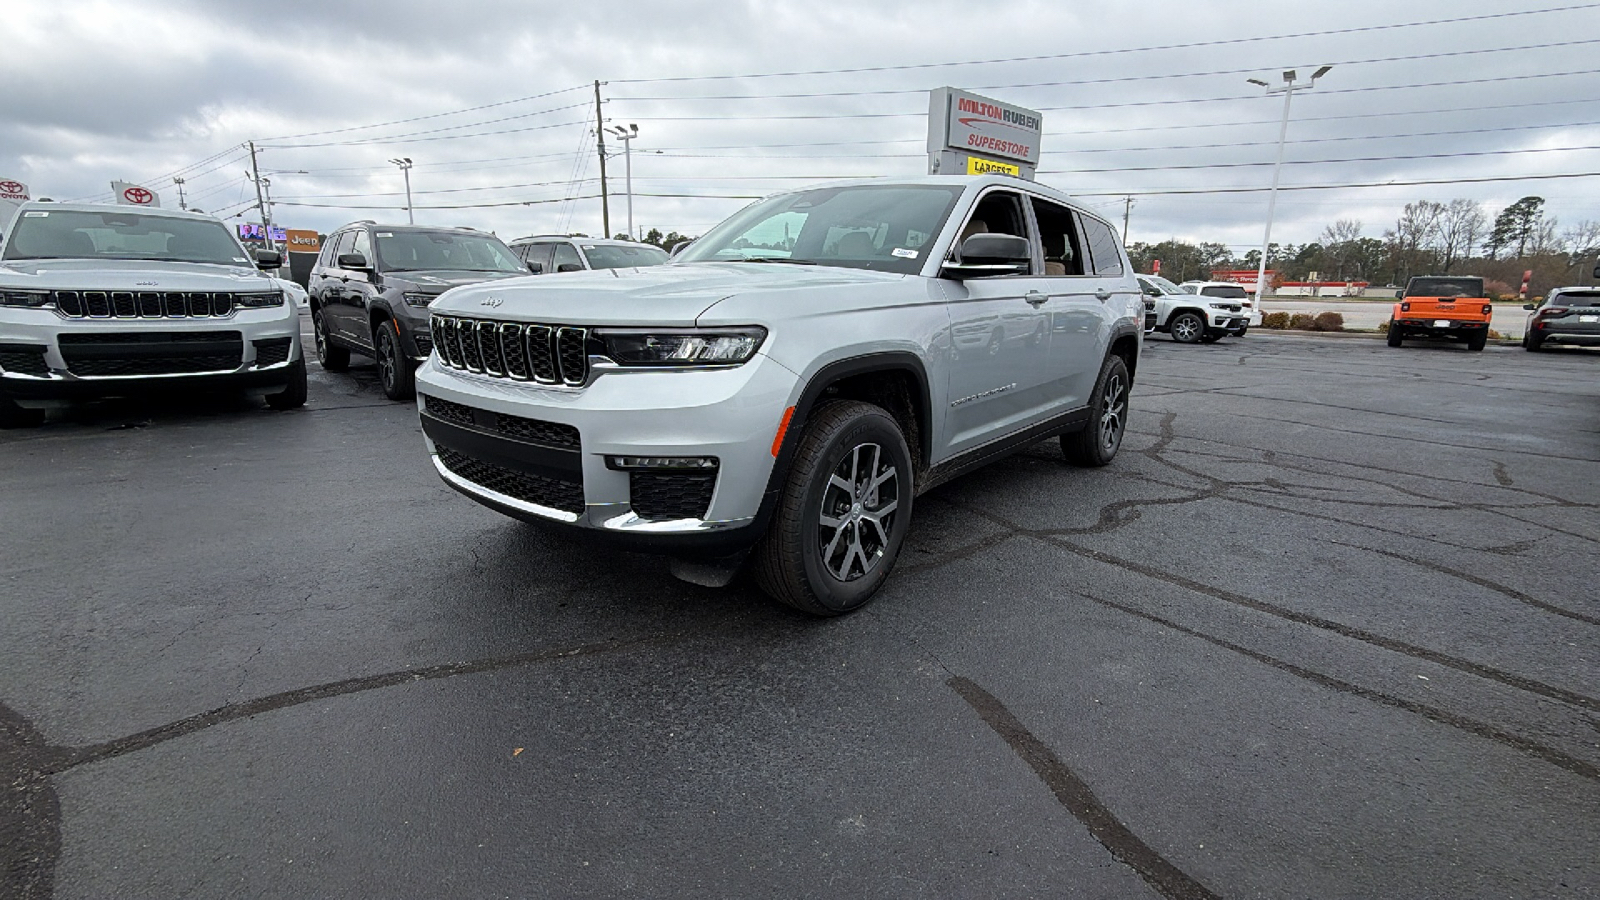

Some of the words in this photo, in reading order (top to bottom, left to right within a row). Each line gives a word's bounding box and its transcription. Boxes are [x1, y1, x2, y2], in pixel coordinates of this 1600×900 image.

[958, 98, 1003, 120] MILTON
[1003, 109, 1039, 131] RUBEN
[967, 133, 1030, 157] SUPERSTORE
[974, 161, 1012, 174] LARGEST
[291, 235, 318, 247] Jeep
[480, 296, 504, 308] Jeep
